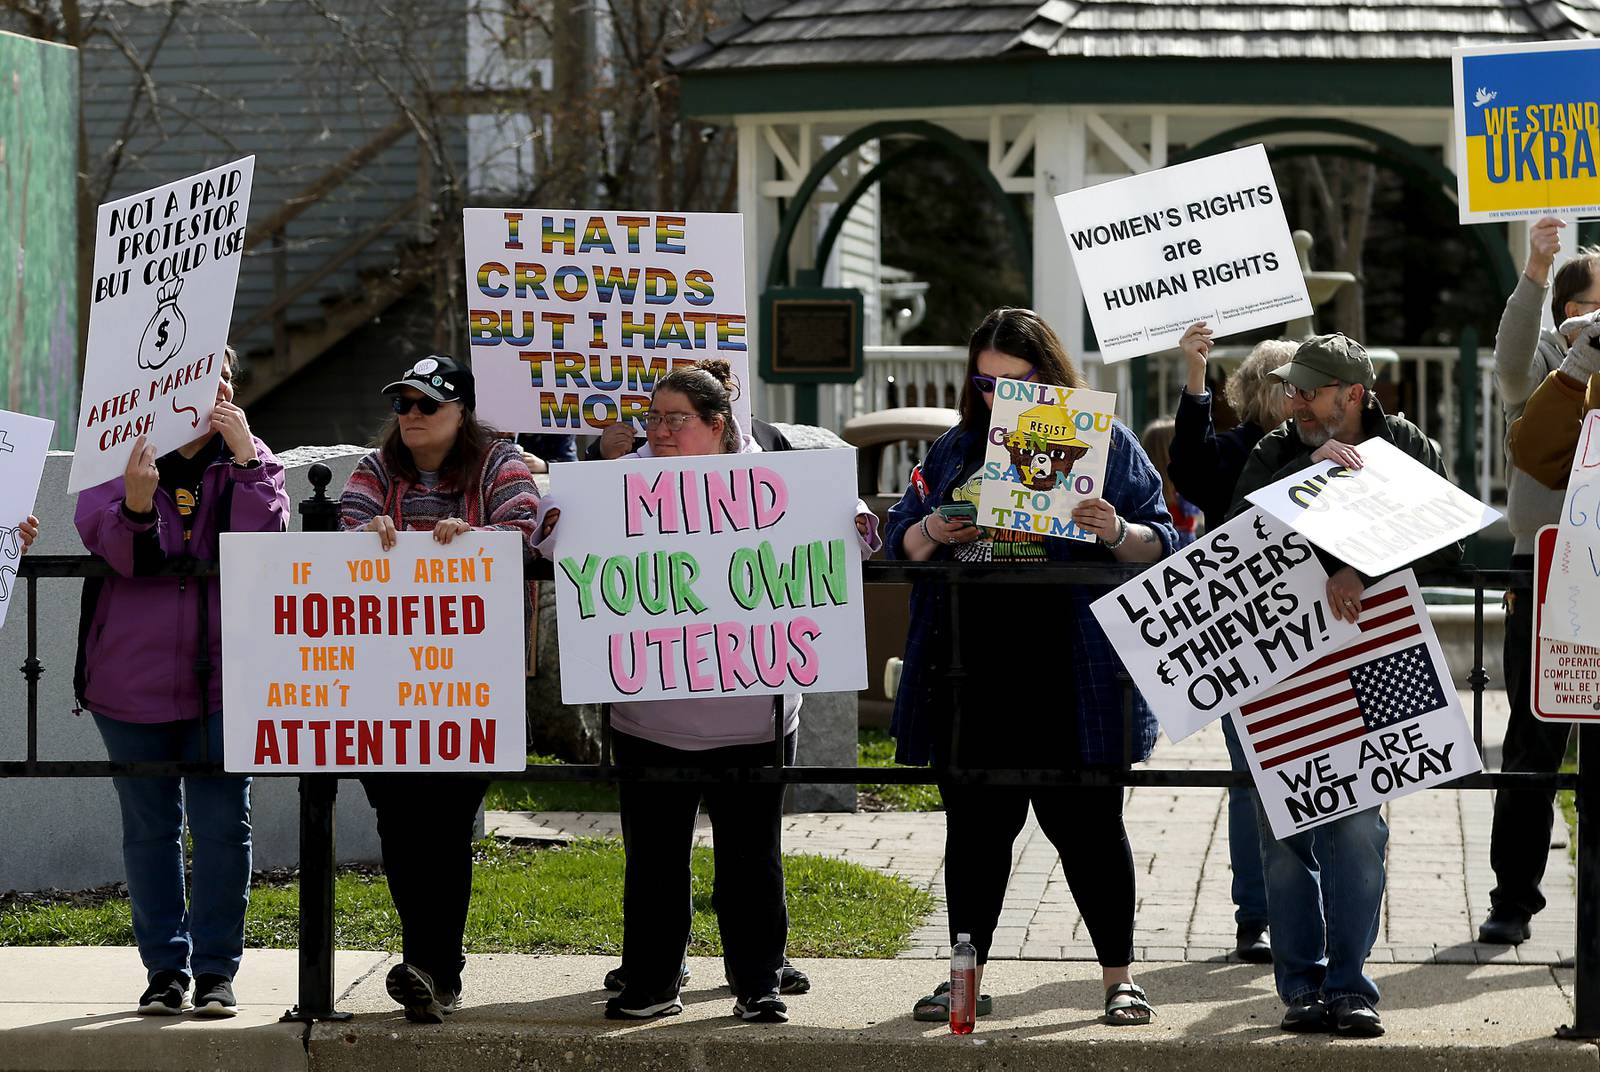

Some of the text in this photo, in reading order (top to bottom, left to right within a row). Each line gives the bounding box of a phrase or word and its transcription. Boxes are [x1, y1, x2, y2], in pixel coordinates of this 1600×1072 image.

[1484, 102, 1599, 135] WE STAND
[1485, 130, 1600, 184] UKRA
[109, 170, 242, 237] NOT A PAID
[1070, 185, 1273, 250] WOMEN'S RIGHTS
[117, 200, 239, 265] PROTESTOR
[504, 212, 686, 255] I HATE
[1162, 238, 1202, 262] are
[95, 226, 245, 303] BUT COULD USE
[476, 261, 715, 306] CROWDS
[1102, 274, 1188, 311] HUMAN
[1192, 252, 1279, 289] RIGHTS
[469, 309, 575, 349] BUT
[588, 312, 608, 349] I
[621, 311, 747, 351] HATE
[86, 353, 215, 428] AFTER MARKET
[519, 351, 698, 392] TRUM
[539, 392, 652, 429] MOR
[997, 381, 1074, 407] ONLY
[99, 411, 156, 452] CRASH
[989, 426, 1050, 451] CAN
[1030, 421, 1067, 436] RESIST
[1060, 408, 1113, 432] YOU
[983, 461, 1094, 494] SAY NO
[624, 466, 789, 538] MIND
[1011, 489, 1051, 512] TO
[292, 547, 494, 584] IF YOU AREN'T
[558, 539, 848, 620] YOUR OWN
[1117, 532, 1240, 625] LIARS
[1139, 531, 1312, 648] CHEATERS
[274, 592, 486, 638] HORRIFIED
[298, 646, 454, 671] THEN YOU
[608, 616, 822, 695] UTERUS
[1187, 600, 1330, 711] OH, MY!
[1550, 644, 1599, 655] AND UNTIL
[266, 679, 491, 707] AREN'T PAYING
[1544, 669, 1597, 679] COMPLETED
[1554, 682, 1574, 692] WILL
[1579, 682, 1590, 692] BE
[1556, 694, 1592, 705] OWNERS
[254, 718, 497, 766] ATTENTION
[1277, 723, 1430, 794] WE ARE
[1284, 742, 1455, 824] NOT OKAY
